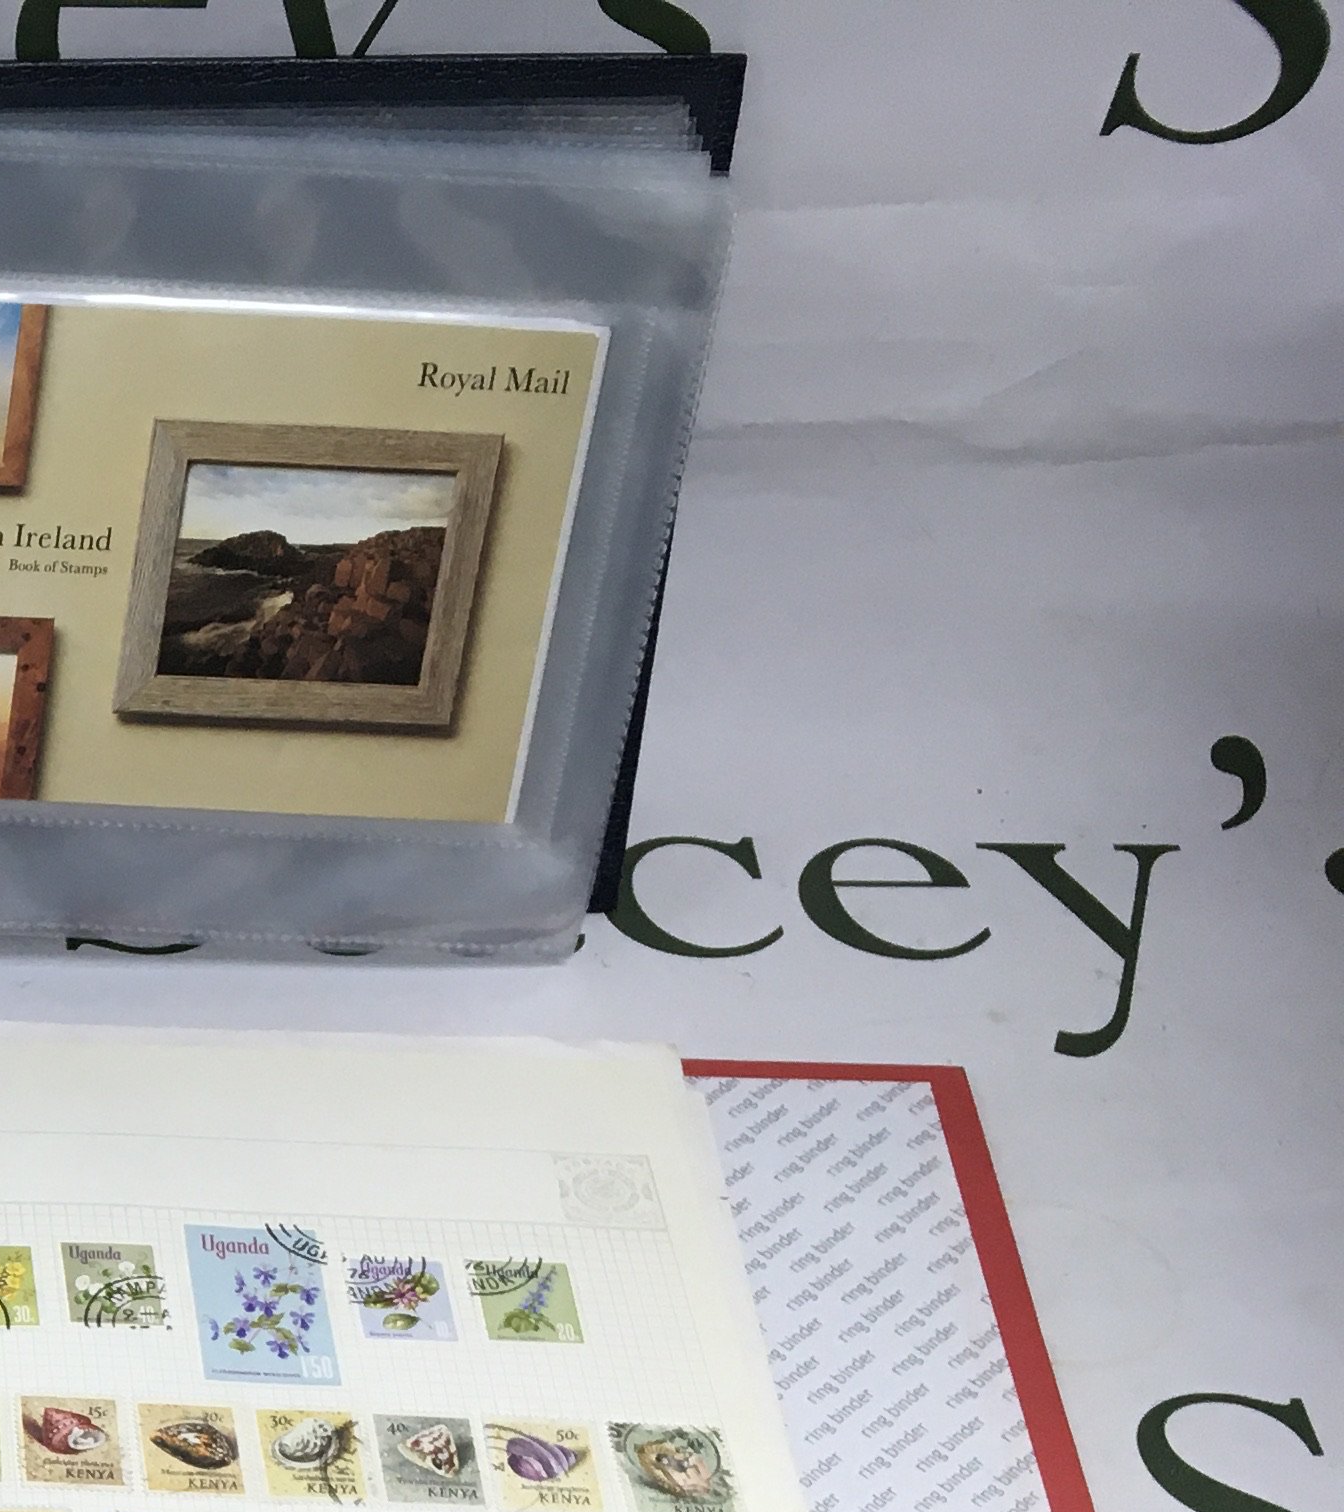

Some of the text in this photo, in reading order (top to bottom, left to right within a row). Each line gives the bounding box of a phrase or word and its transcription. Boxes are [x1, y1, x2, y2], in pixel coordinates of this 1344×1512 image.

[417, 362, 571, 397] Royal Mail
[13, 522, 112, 552] Ireland
[8, 557, 109, 580] Book of Stamps
[827, 1127, 891, 1178] ring binder
[68, 1245, 121, 1264] Uganda
[200, 1233, 270, 1259] Uganda
[555, 1429, 580, 1443] 50c
[427, 1485, 479, 1501] KENYA
